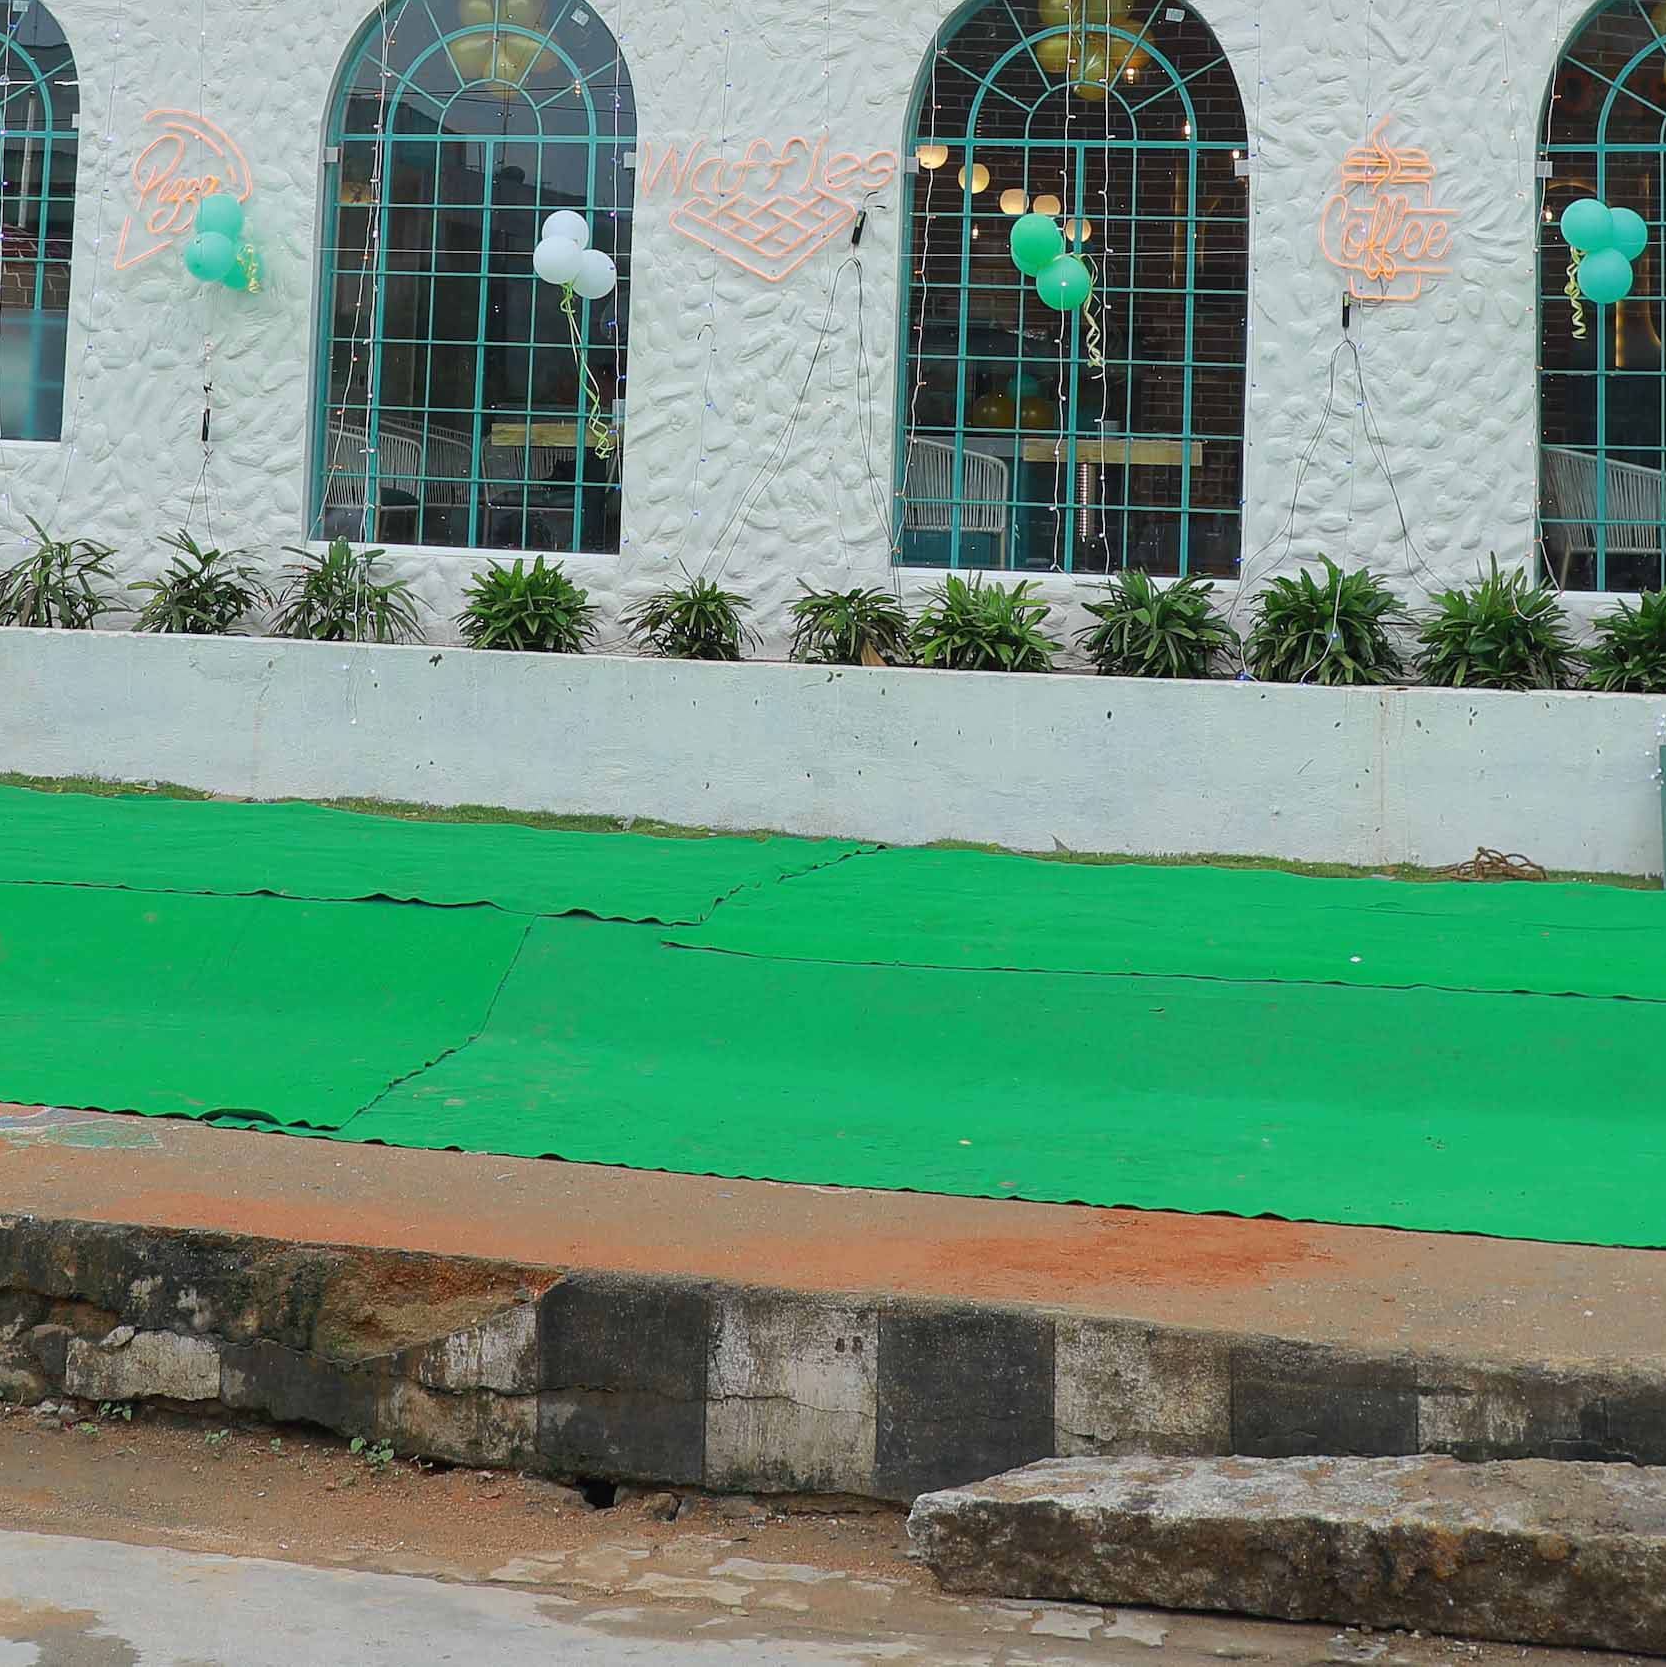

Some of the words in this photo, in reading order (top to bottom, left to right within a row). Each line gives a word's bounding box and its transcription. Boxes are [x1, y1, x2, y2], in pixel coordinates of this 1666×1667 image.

[133, 134, 221, 235] Pizza
[641, 134, 898, 197] Waffles
[1319, 194, 1454, 280] Coffee
